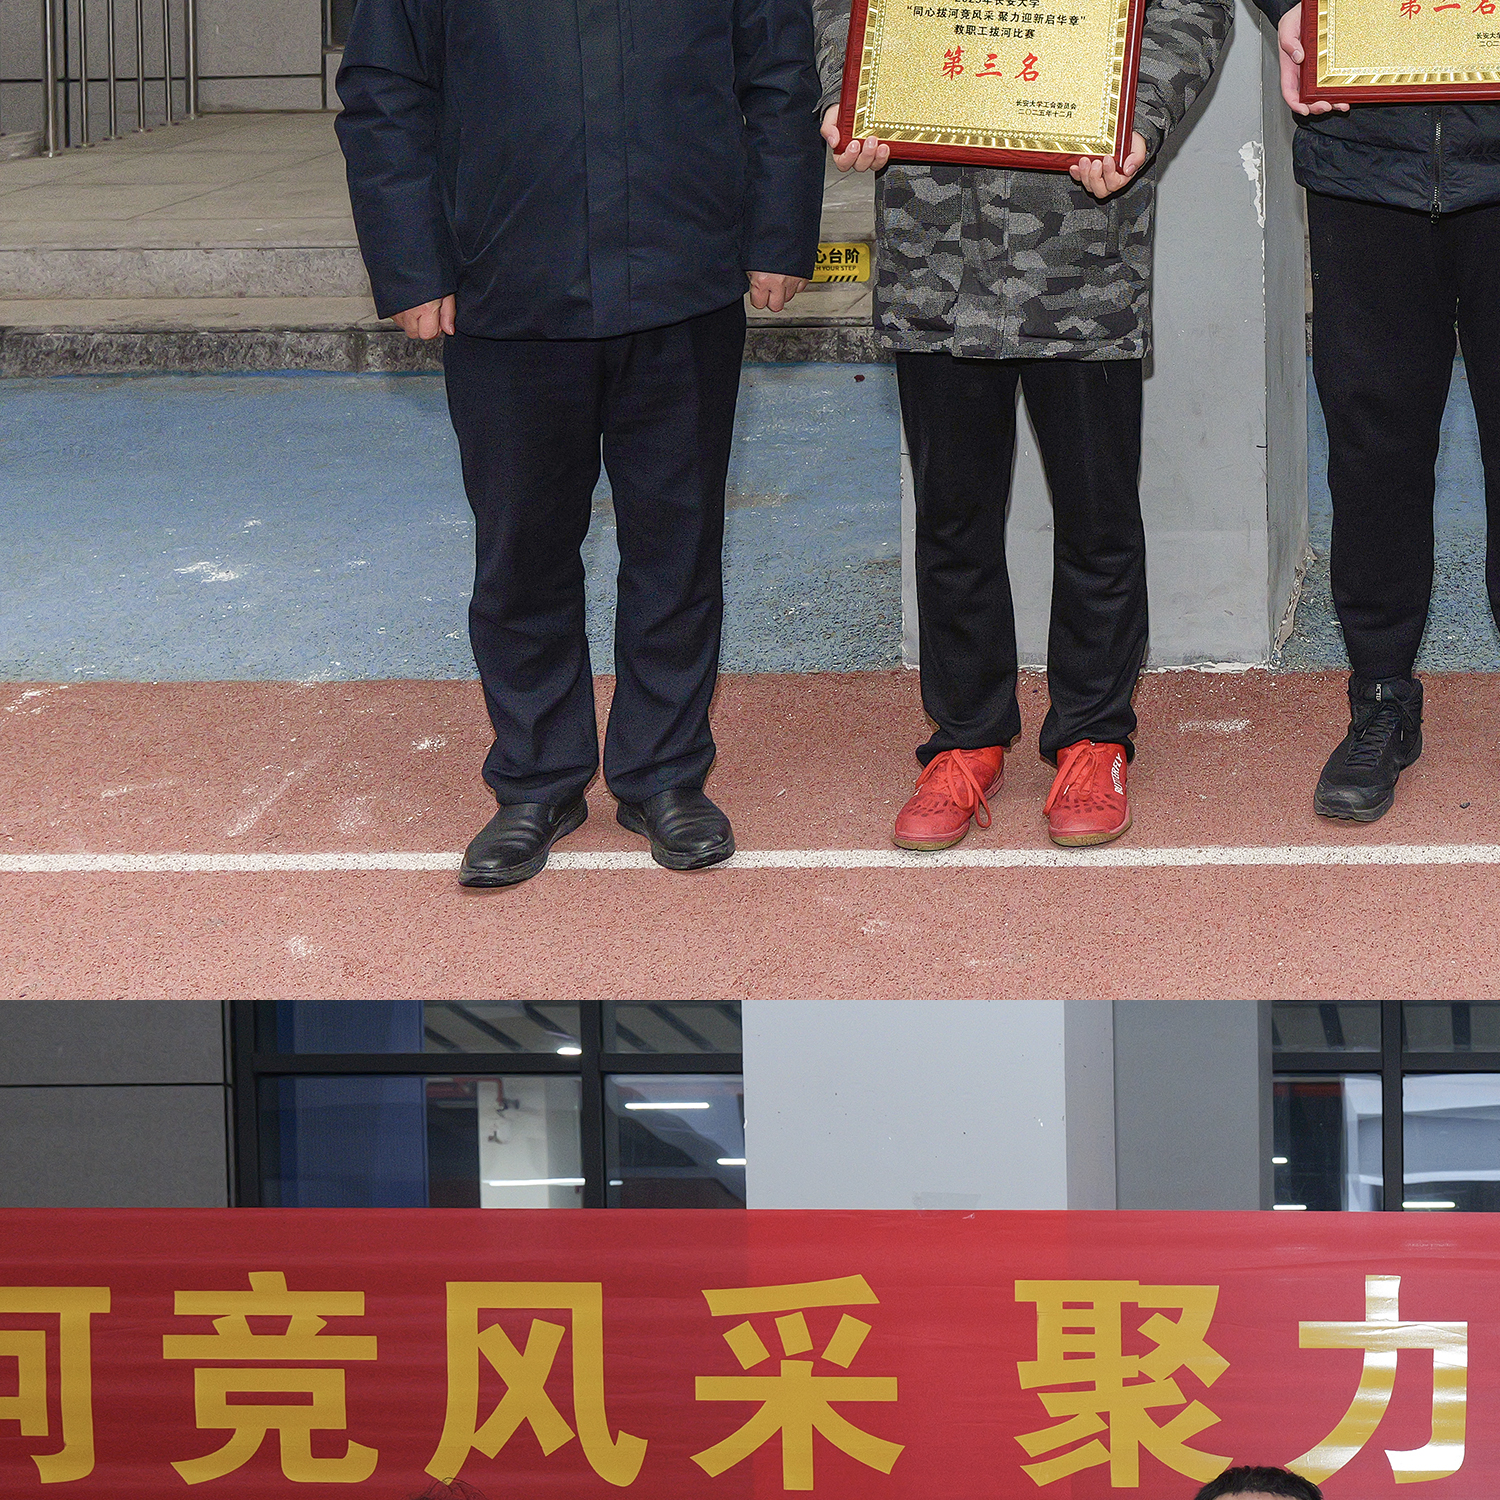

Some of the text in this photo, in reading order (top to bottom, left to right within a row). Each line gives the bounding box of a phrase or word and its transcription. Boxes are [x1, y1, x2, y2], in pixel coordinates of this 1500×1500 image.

[954, 24, 1035, 40] 教职工拔河比赛
[941, 45, 1040, 82] 第三名
